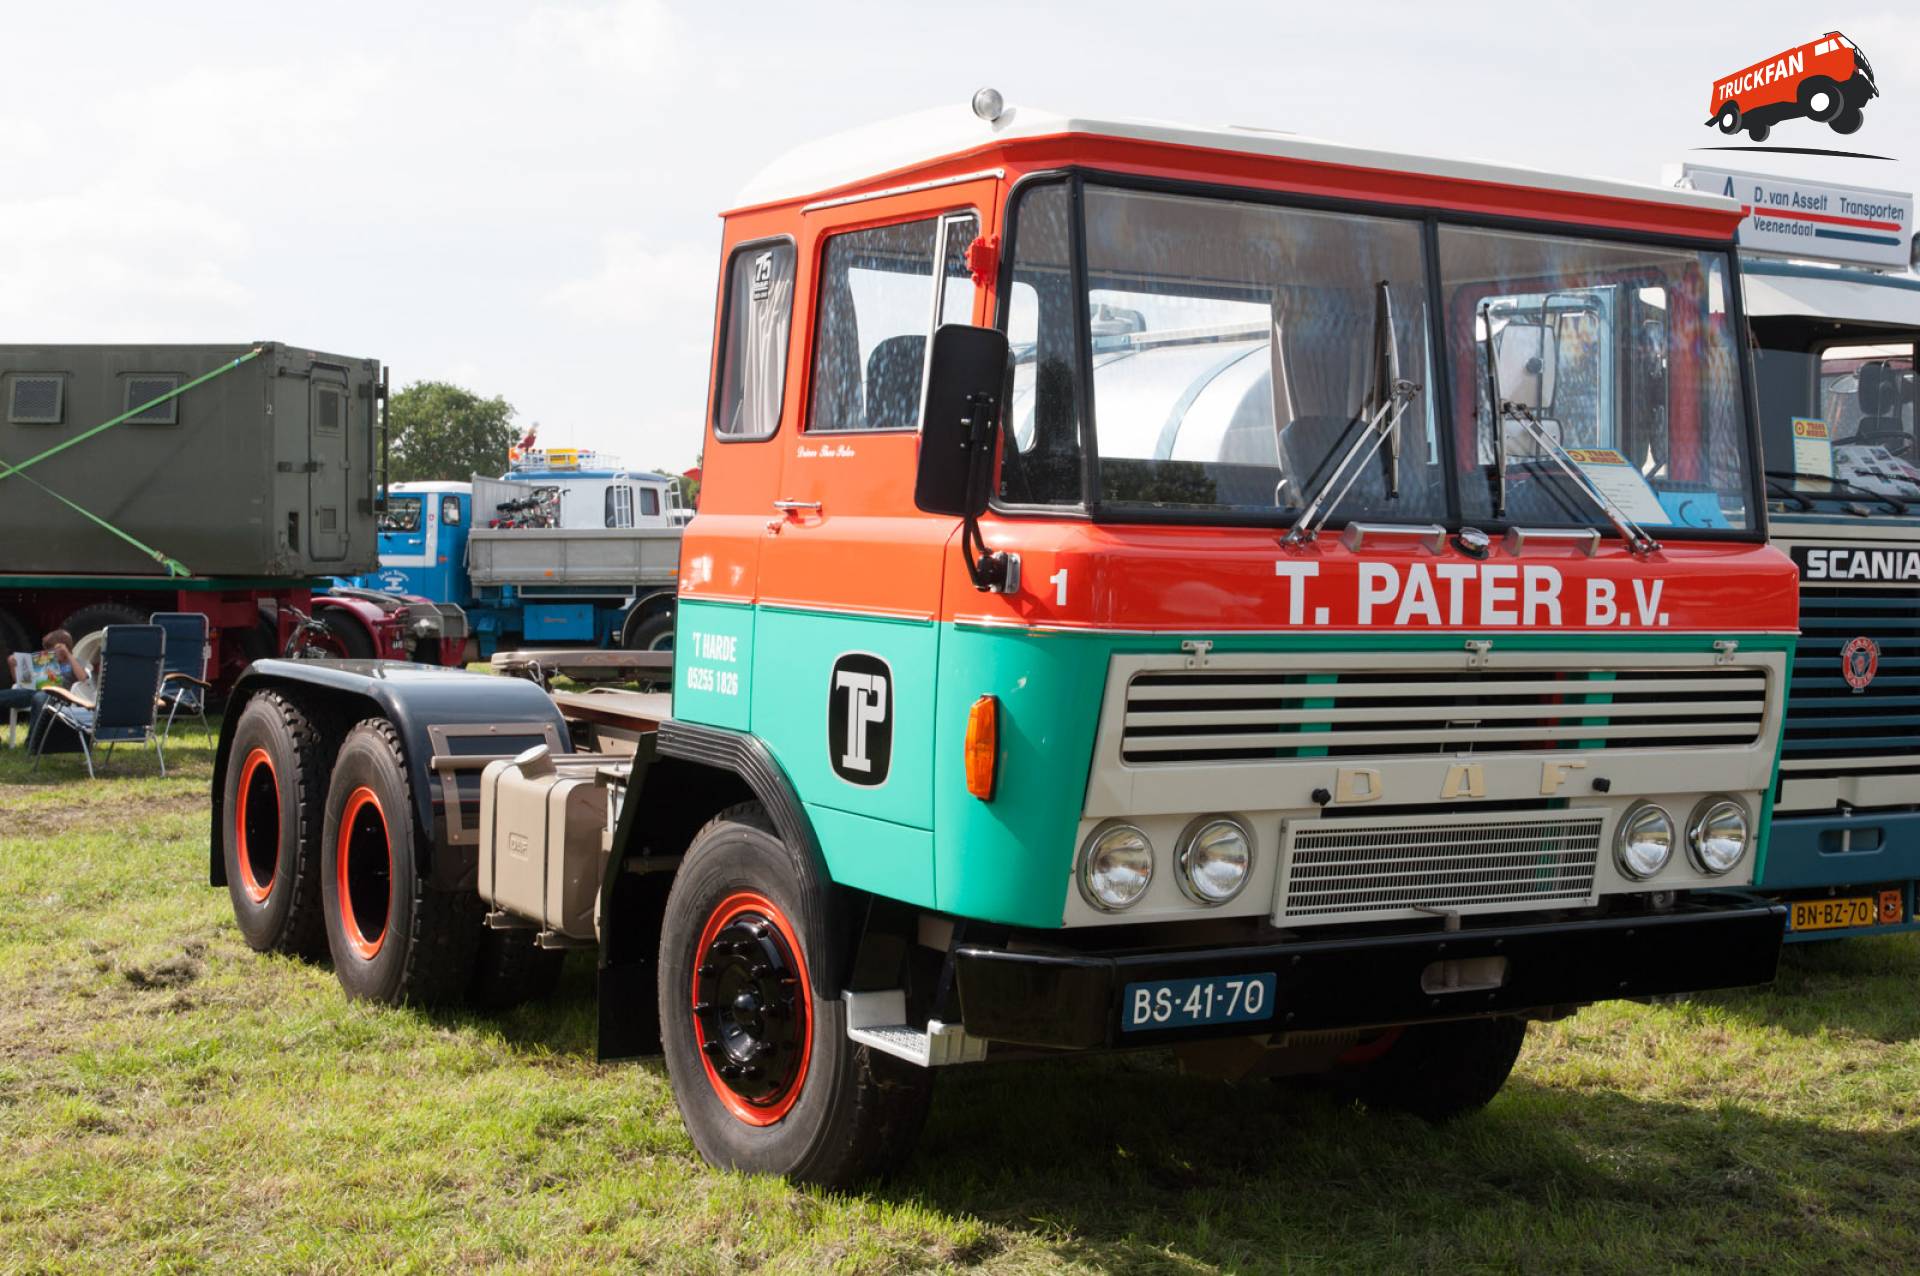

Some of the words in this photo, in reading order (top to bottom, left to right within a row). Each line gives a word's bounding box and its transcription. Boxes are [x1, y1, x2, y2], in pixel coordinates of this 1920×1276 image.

[1792, 191, 1828, 211] Asselt
[1839, 197, 1904, 221] Transporten
[1753, 215, 1814, 237] Veenendaal
[1806, 549, 1920, 580] SCANIA
[1049, 569, 1068, 606] 1
[1275, 561, 1330, 625] T.
[1357, 561, 1563, 626] PATER
[1585, 578, 1670, 627] B.V.
[702, 633, 738, 663] HARDE
[716, 671, 739, 696] 1826
[836, 670, 887, 773] TP
[1334, 761, 1588, 804] DAF
[1796, 901, 1868, 926] BN-BZ-70
[1133, 980, 1265, 1025] BS-41-70
